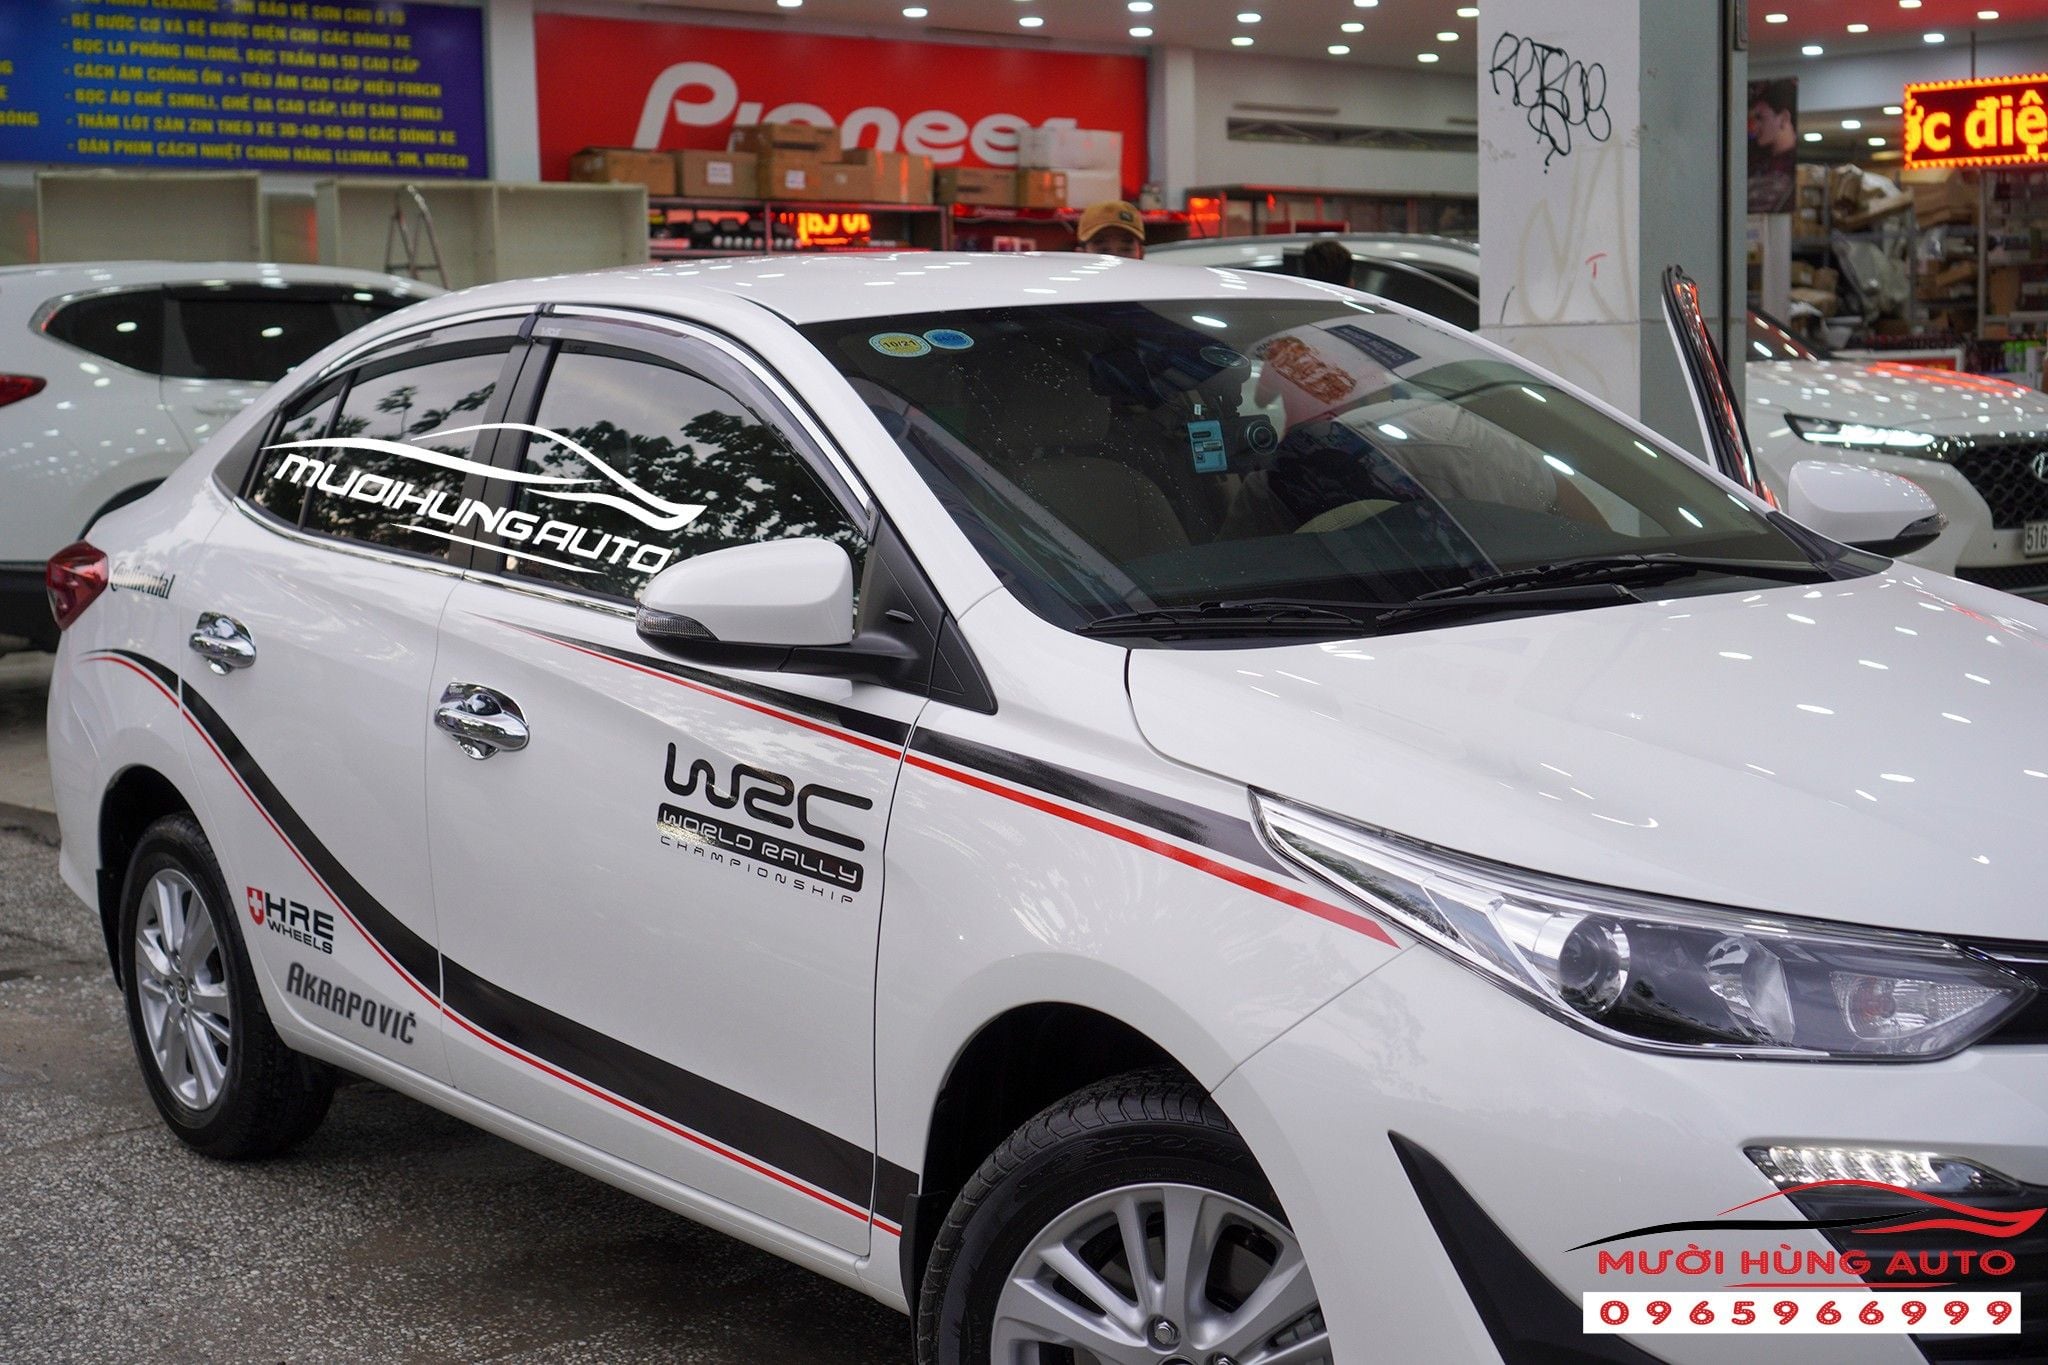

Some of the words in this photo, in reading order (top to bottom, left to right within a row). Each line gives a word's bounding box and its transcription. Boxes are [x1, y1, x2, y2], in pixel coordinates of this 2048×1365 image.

[664, 742, 873, 852] WRC
[660, 836, 853, 904] CHAMPIONSHIP
[662, 809, 753, 851] WORLD
[761, 841, 858, 884] RALLY
[265, 892, 334, 941] HRE
[267, 919, 333, 955] WHEELS
